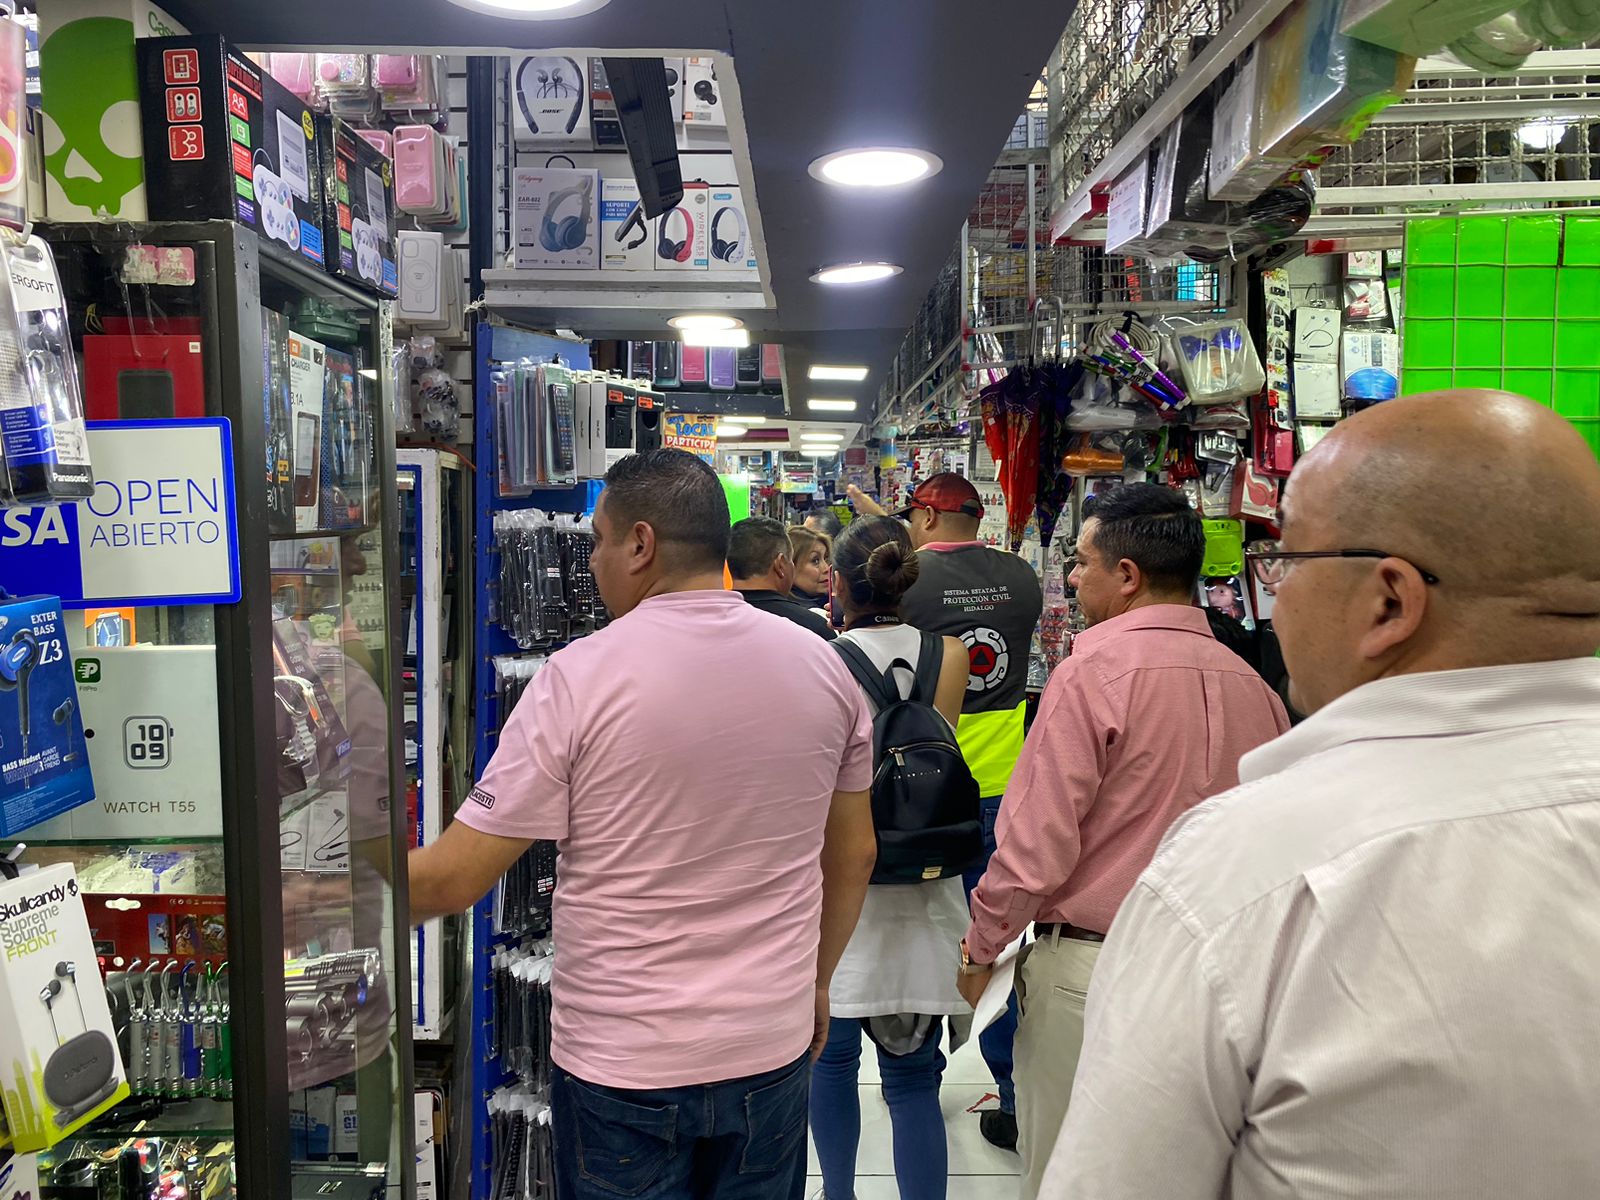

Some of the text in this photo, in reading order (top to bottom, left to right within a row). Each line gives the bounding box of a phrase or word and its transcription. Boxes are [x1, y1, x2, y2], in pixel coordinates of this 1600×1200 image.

[11, 272, 54, 294] ERGOFIT
[676, 422, 716, 436] LOCAL
[666, 436, 715, 449] PARTICIPA
[53, 472, 89, 483] Panasonic
[87, 478, 219, 518] OPEN
[90, 520, 220, 549] ABIERTO
[991, 593, 1012, 602] CIVIL
[964, 604, 995, 612] HIDALGO
[31, 611, 58, 625] EXTER
[33, 623, 56, 637] BASS
[38, 639, 63, 666] Z3
[138, 724, 165, 742] 10
[41, 746, 57, 757] AVANT
[42, 752, 60, 764] GARDE
[131, 743, 165, 760] 09
[2, 753, 41, 773] BASS Headset
[44, 759, 61, 770] TREND
[104, 801, 196, 814] WATCH T55
[0, 884, 65, 922] Skullcandy
[0, 905, 60, 937] Supreme
[2, 920, 47, 949] Sound
[6, 929, 57, 961] FRONT
